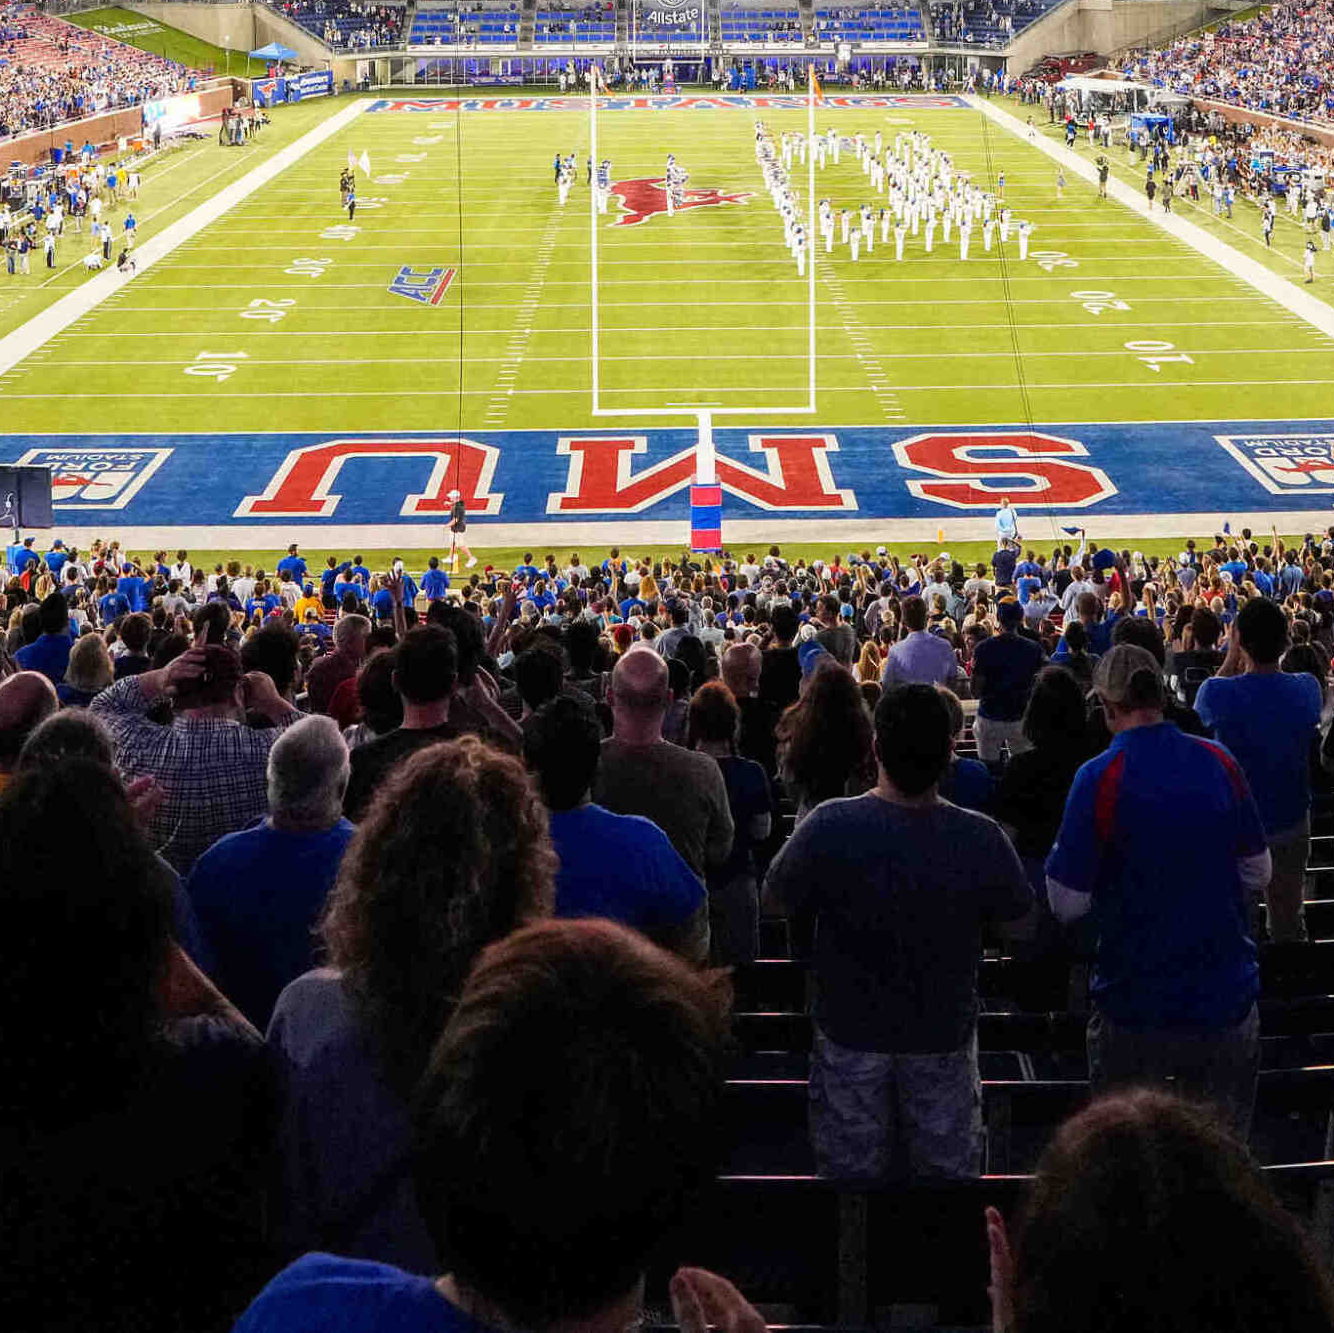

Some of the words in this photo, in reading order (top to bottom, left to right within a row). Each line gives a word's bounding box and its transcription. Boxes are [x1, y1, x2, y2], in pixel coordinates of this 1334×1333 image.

[647, 8, 699, 25] Allstate
[387, 265, 444, 304] ACC
[238, 298, 297, 320] 20
[1070, 290, 1132, 312] 20
[183, 349, 250, 377] 10
[1123, 340, 1195, 367] 10
[46, 453, 145, 461] STADIUM
[232, 431, 1120, 517] SMU
